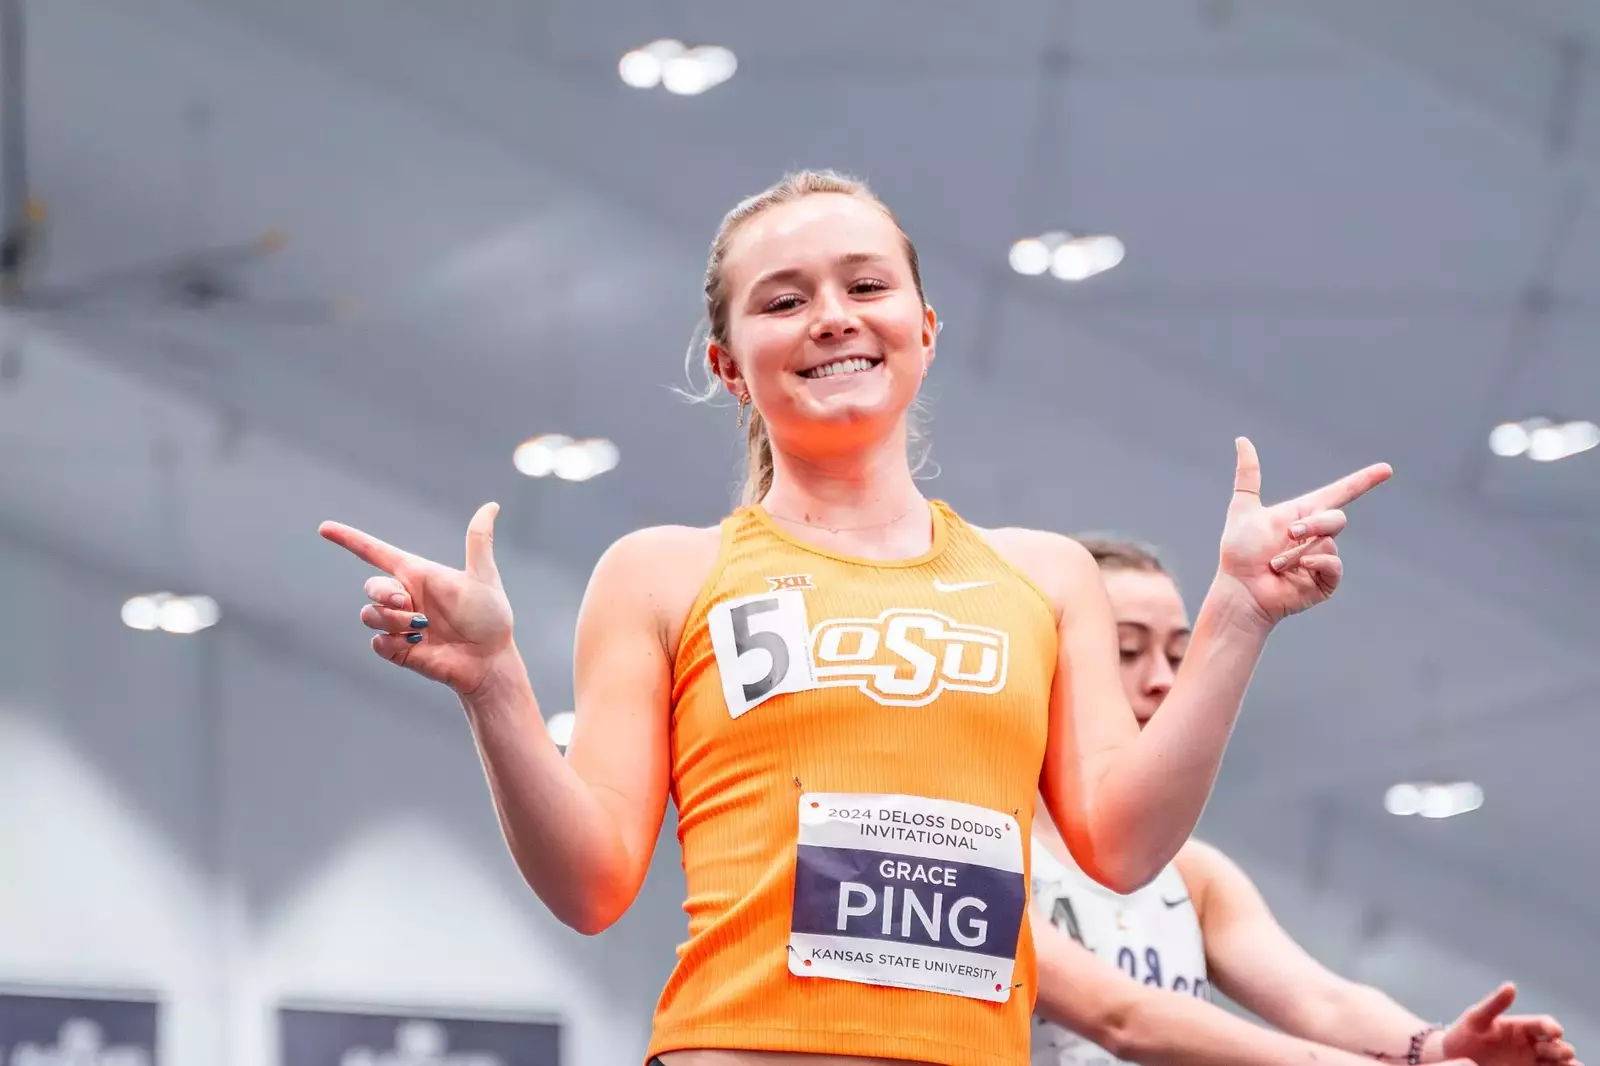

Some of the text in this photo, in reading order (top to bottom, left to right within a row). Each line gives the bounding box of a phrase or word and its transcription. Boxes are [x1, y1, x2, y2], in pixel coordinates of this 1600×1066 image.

[772, 576, 812, 590] XII
[730, 598, 790, 702] 5
[828, 808, 1002, 840] 2024 DELOSS DODDS
[859, 823, 979, 851] INVITATIONAL
[879, 860, 958, 887] GRACE
[836, 881, 989, 947] PING
[811, 948, 998, 981] KANSAS STATE UNIVERSITY
